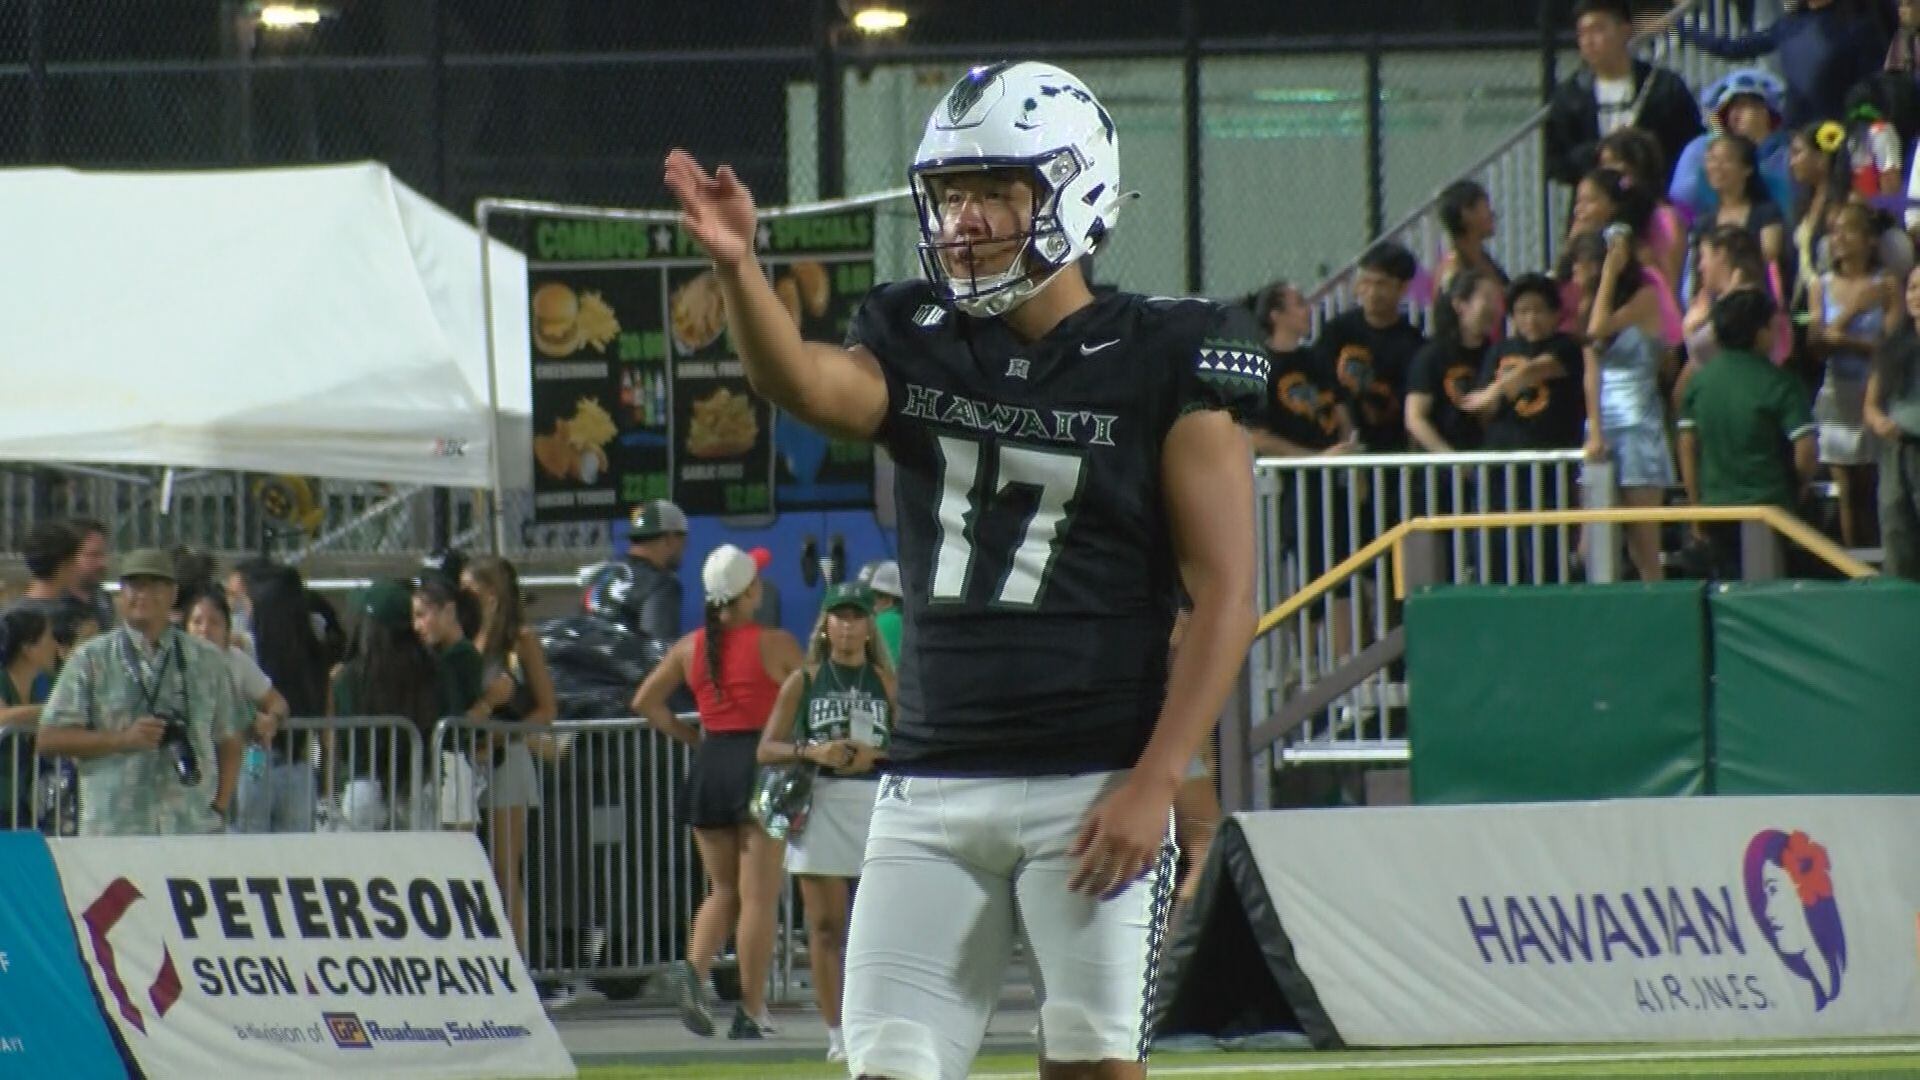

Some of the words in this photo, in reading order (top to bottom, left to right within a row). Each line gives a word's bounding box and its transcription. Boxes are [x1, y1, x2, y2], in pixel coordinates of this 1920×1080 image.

[771, 212, 872, 250] SPECIALS
[1006, 358, 1031, 380] H
[901, 384, 1119, 447] HAWAI'I
[929, 432, 1086, 608] 17
[166, 877, 502, 940] PETERSON
[1458, 886, 1746, 964] HAWAIIAN
[193, 956, 298, 996] SIGN
[317, 956, 518, 996] COMPANY
[365, 1020, 452, 1047] Roadway
[444, 1020, 531, 1041] Solutions
